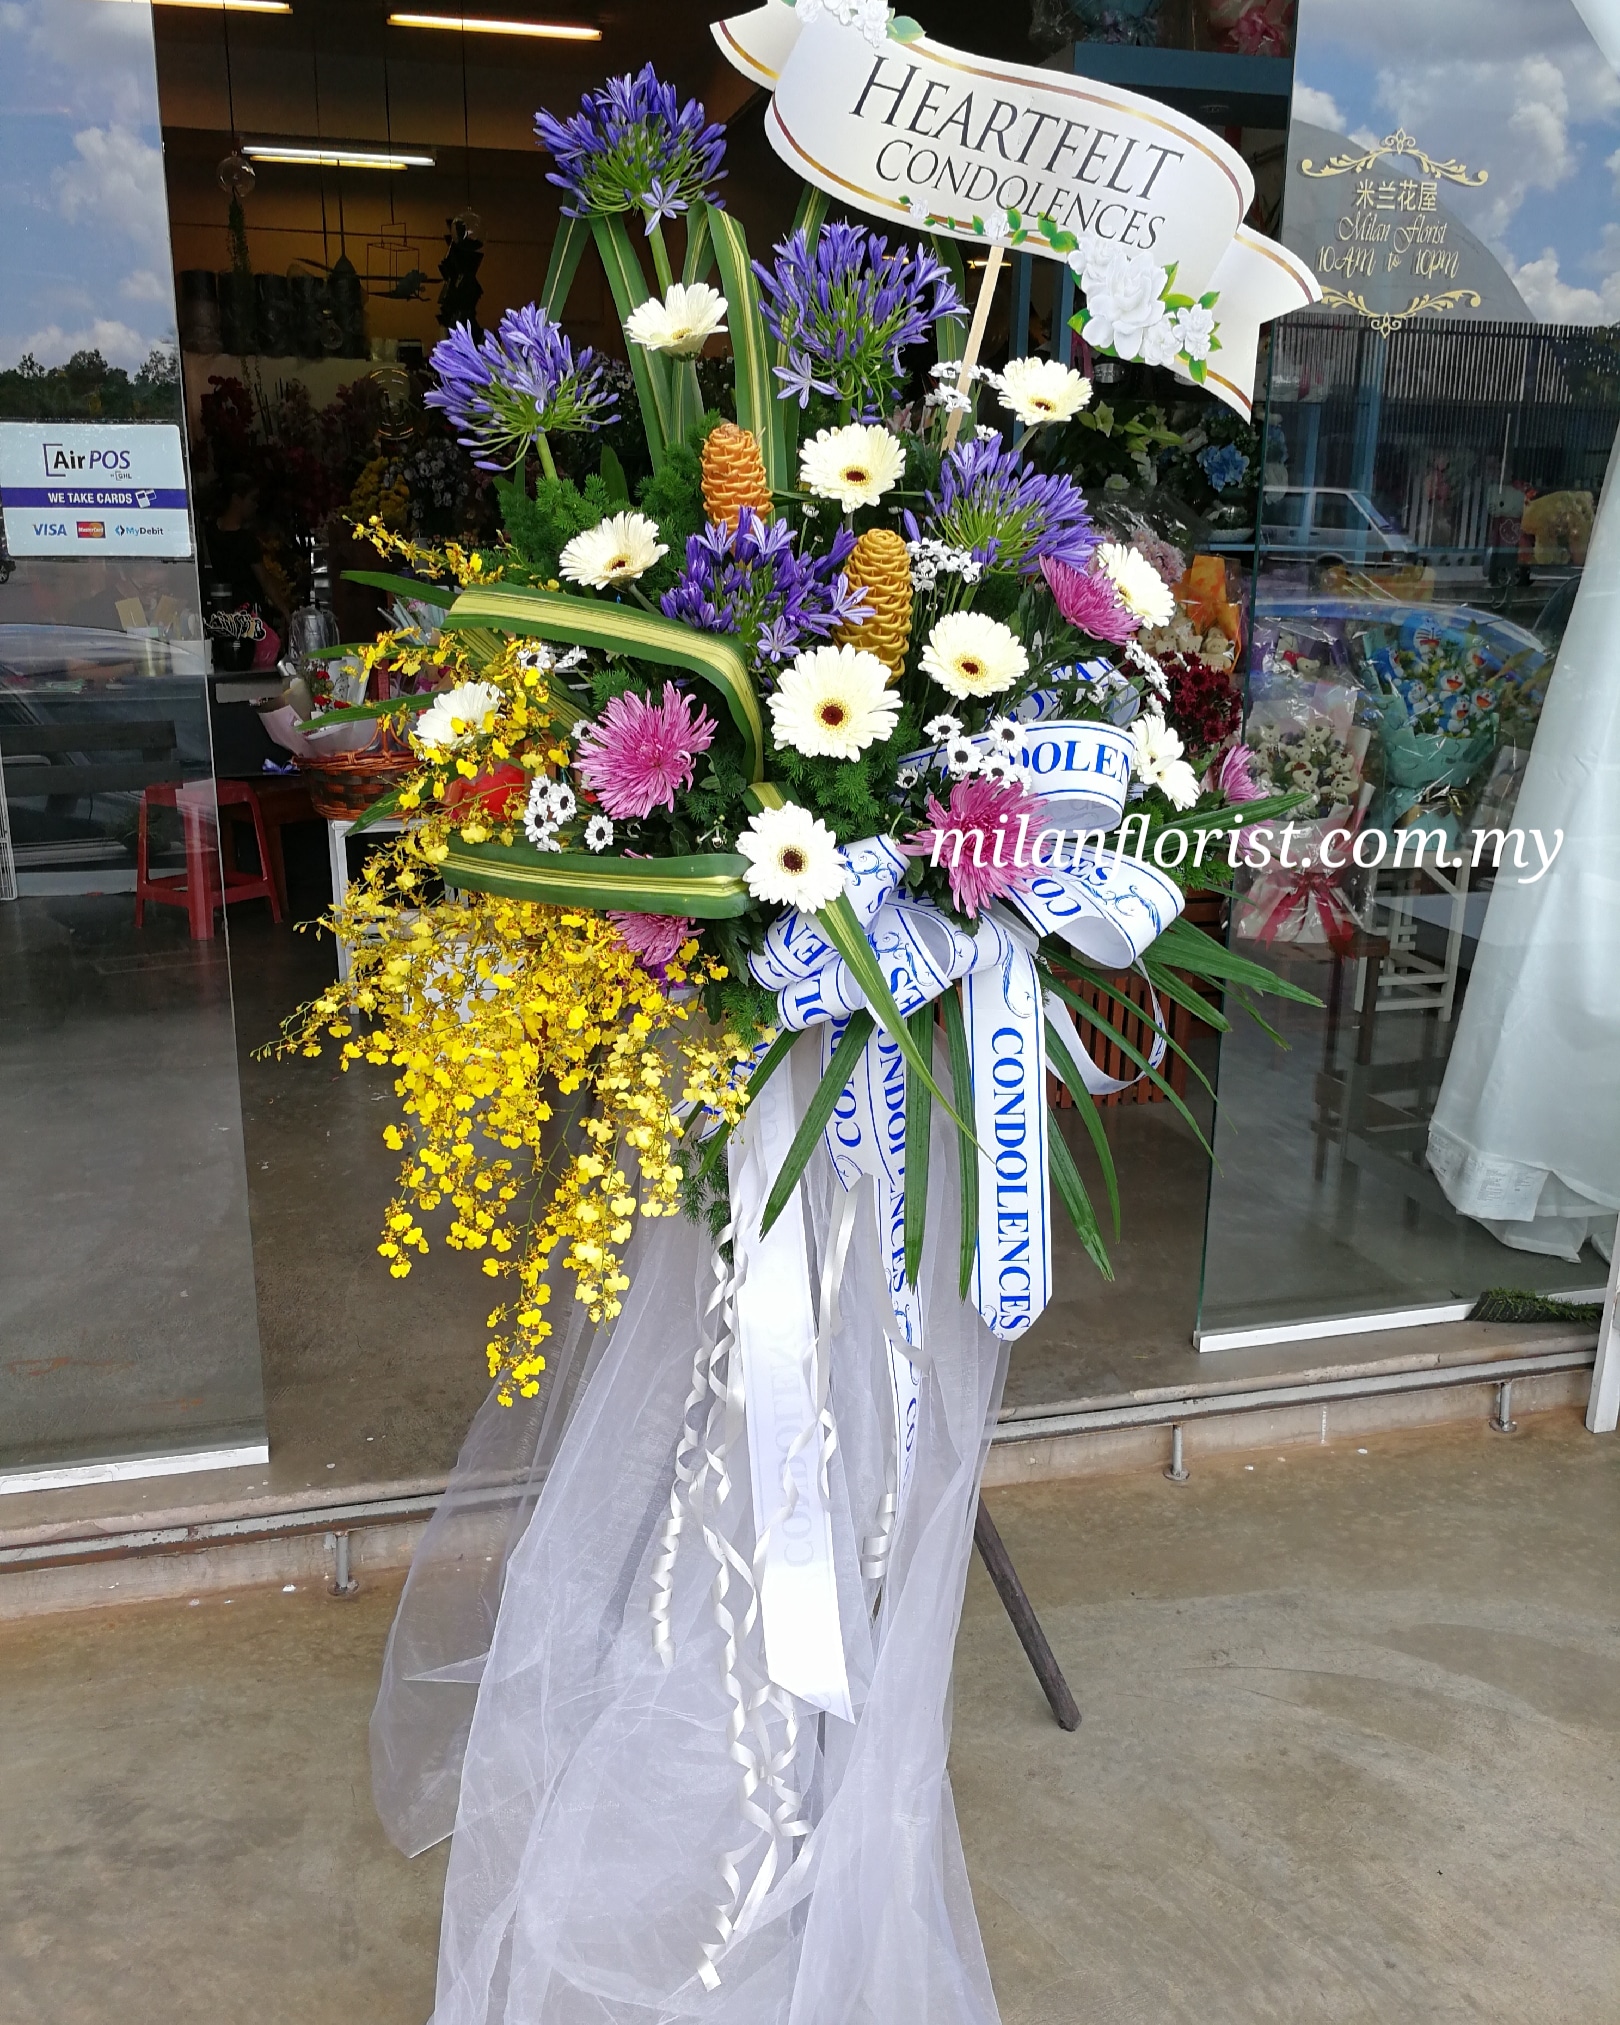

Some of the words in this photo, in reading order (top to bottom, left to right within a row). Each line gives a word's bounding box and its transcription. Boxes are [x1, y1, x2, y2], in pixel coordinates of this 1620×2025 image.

[848, 54, 1184, 202] HEARTFELT
[875, 139, 1166, 251] CONDOLENCES
[1356, 178, 1438, 212] 米兰花屋
[1338, 211, 1391, 242] Milan
[1387, 251, 1402, 273] to
[48, 492, 66, 504] WE
[67, 492, 95, 504] TAKE
[96, 492, 133, 505] CARDS
[33, 523, 68, 537] VISA
[126, 526, 164, 537] MyDebit
[991, 1026, 1032, 1331] CONDOLENCES
